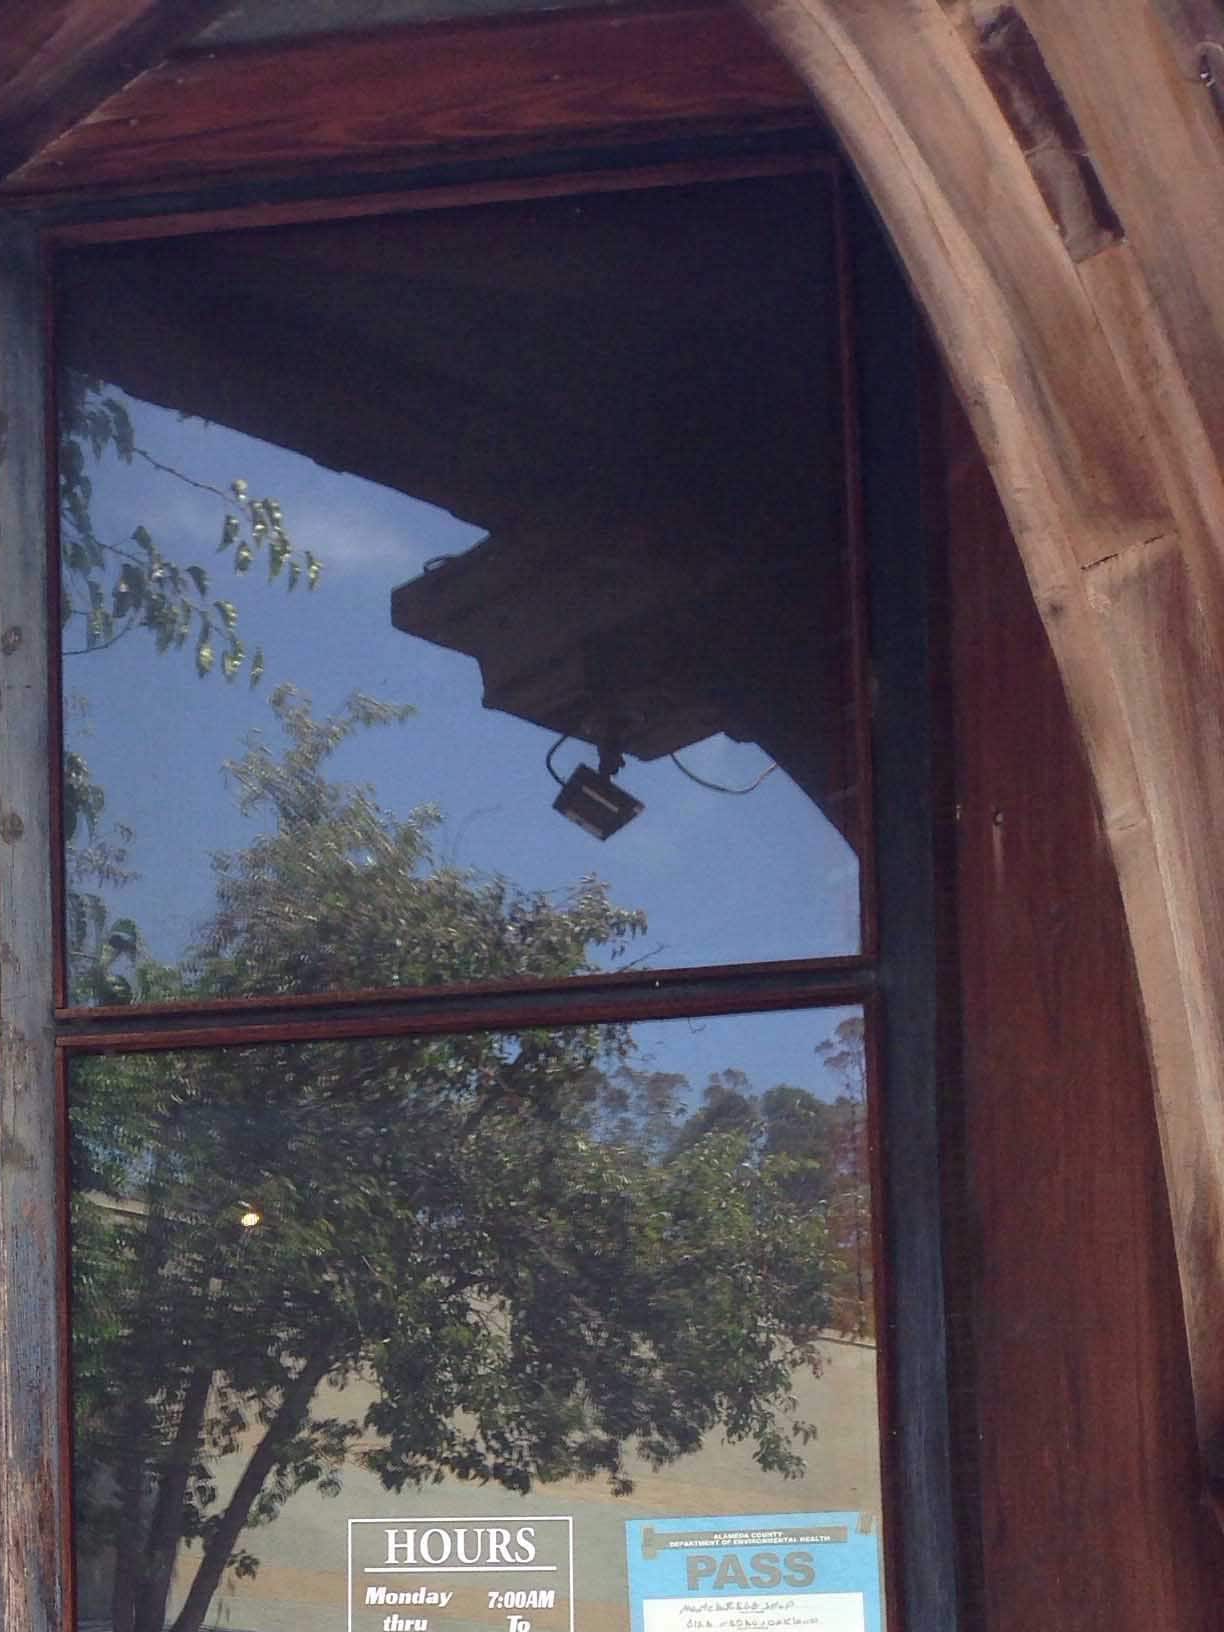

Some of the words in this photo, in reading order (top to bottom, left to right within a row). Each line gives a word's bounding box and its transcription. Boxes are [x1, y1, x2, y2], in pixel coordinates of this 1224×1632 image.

[384, 1526, 536, 1565] HOURS
[669, 1540, 720, 1548] DEPARTMENT
[799, 1535, 831, 1543] HEALTH
[713, 1532, 749, 1540] ALAMEDA
[751, 1531, 784, 1539] COUNTY
[687, 1551, 815, 1591] PASS
[365, 1586, 454, 1608] Monday
[488, 1590, 555, 1609] 7:00AM
[383, 1614, 428, 1632] thru
[507, 1615, 531, 1632] To
